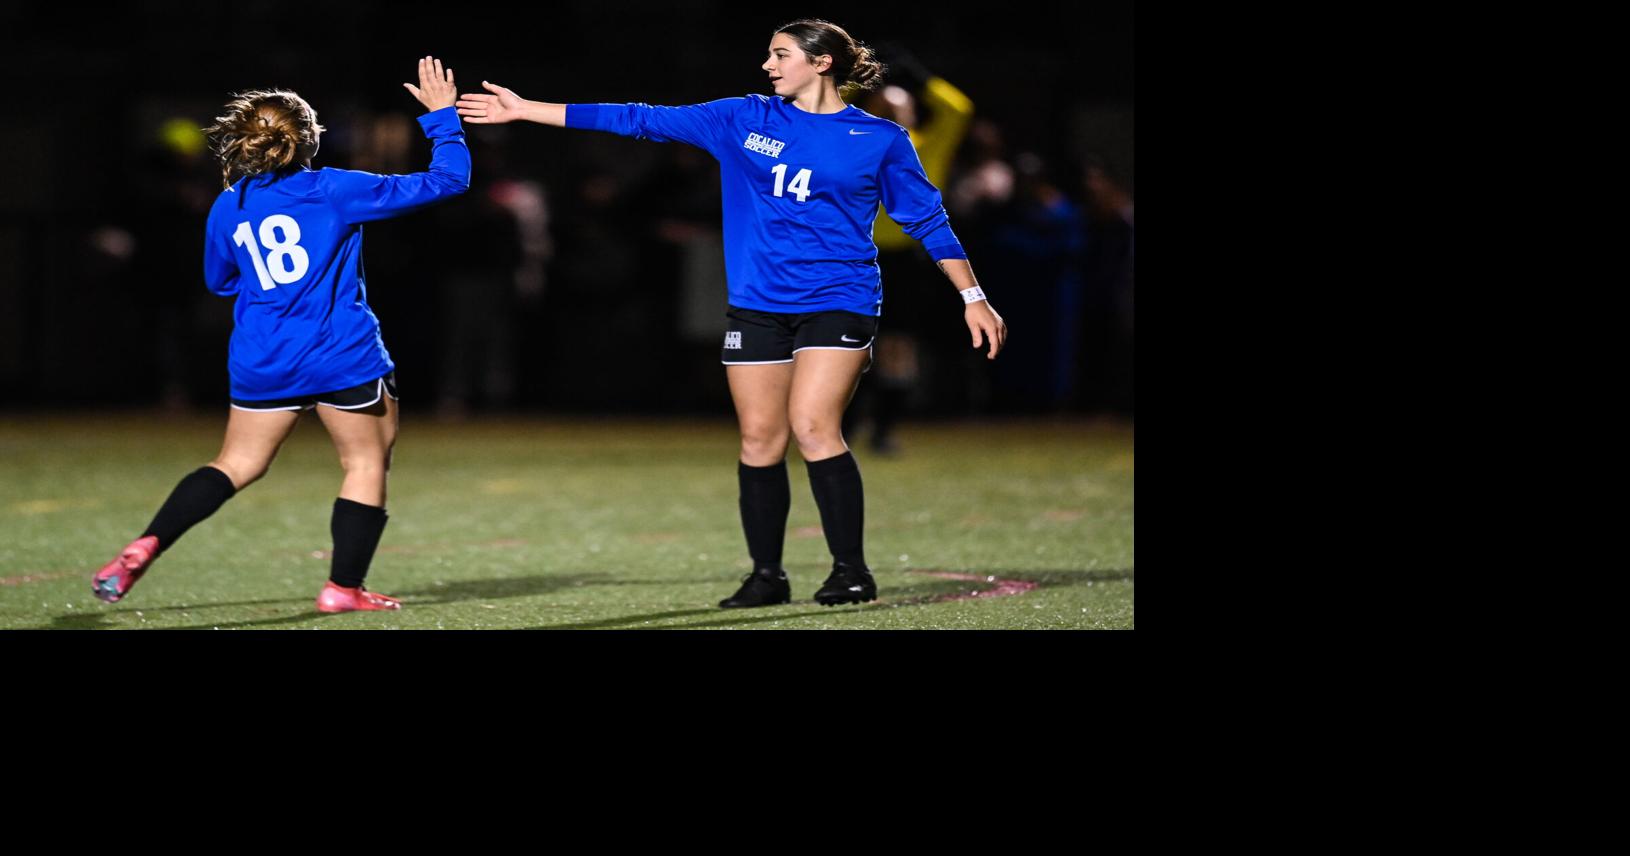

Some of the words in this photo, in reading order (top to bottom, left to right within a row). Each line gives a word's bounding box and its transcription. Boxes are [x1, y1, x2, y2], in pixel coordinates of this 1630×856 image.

[744, 142, 779, 158] SOCCER
[748, 132, 785, 149] COCALICO
[771, 163, 812, 202] 14
[232, 214, 309, 291] 18
